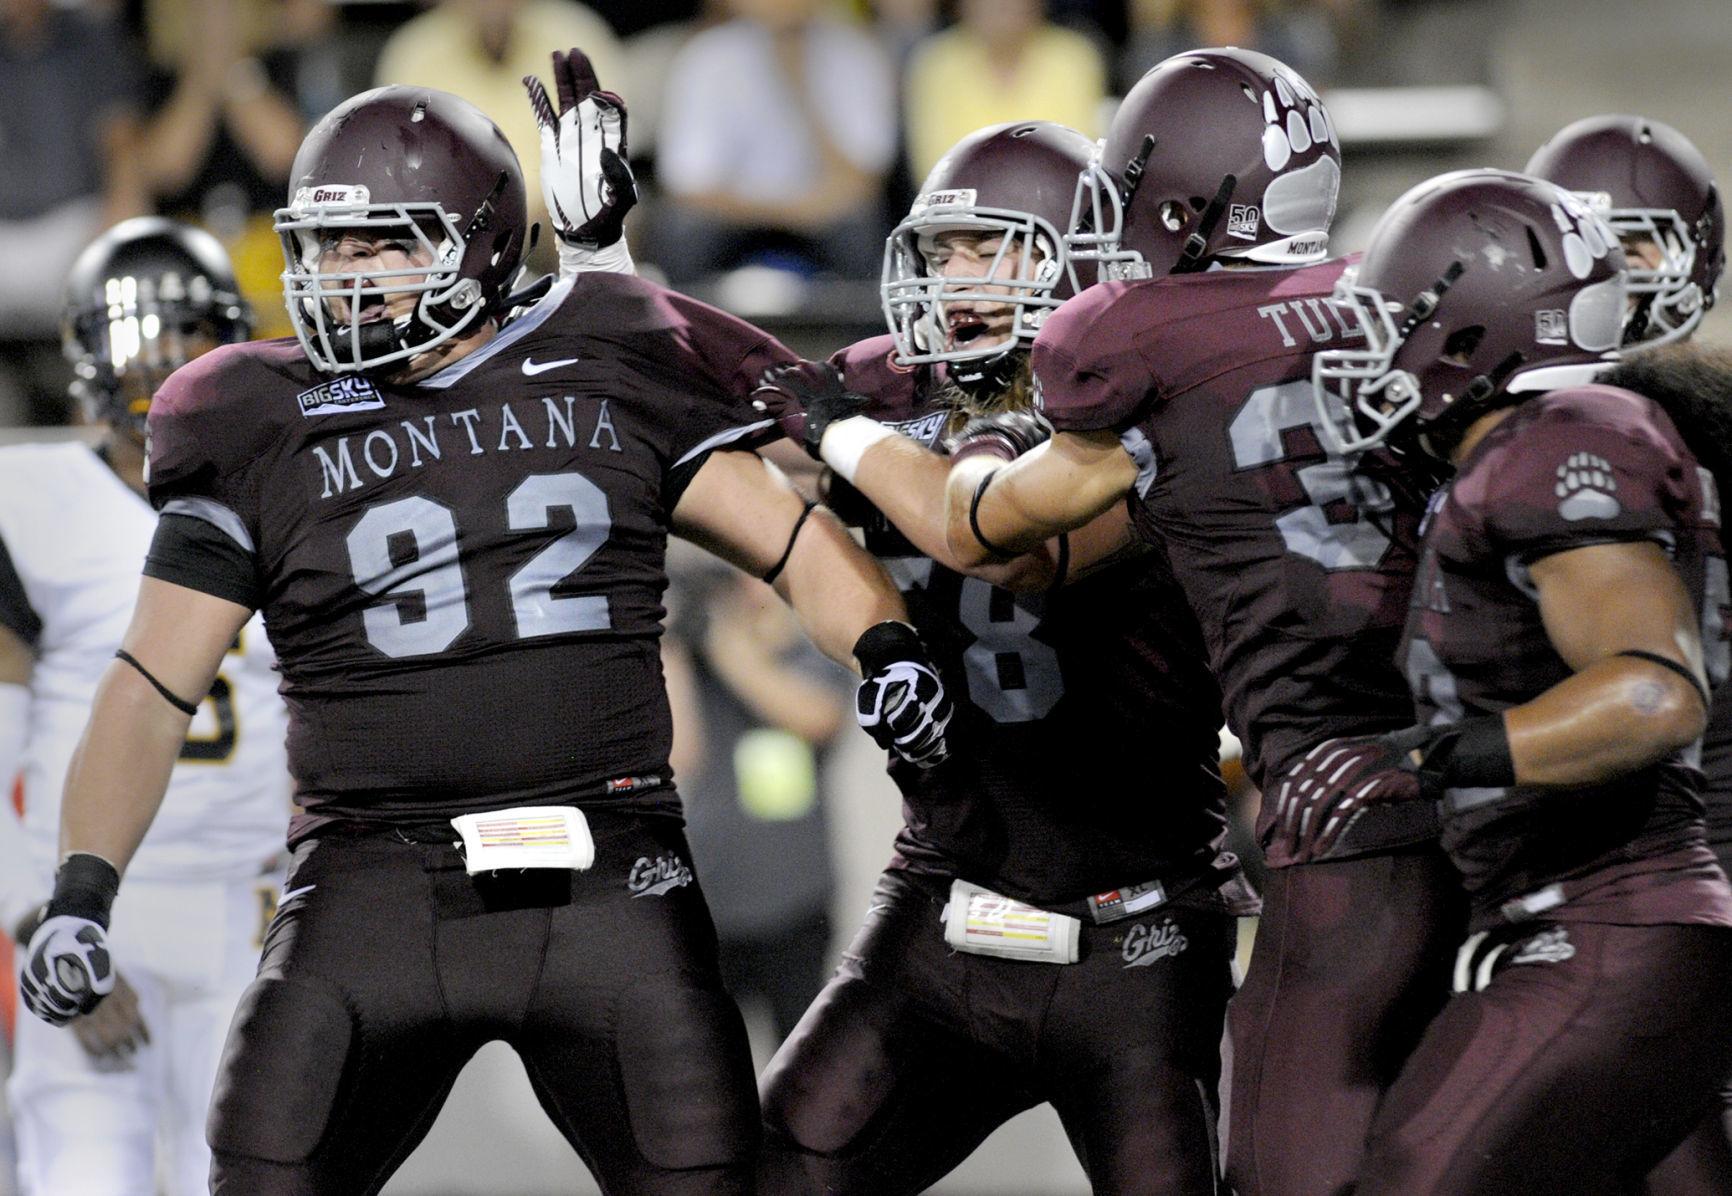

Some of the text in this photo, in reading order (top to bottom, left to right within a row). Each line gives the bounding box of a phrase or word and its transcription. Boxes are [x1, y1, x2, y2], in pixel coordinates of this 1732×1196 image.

[313, 188, 348, 203] GRIZ
[1230, 203, 1260, 223] 50
[312, 395, 622, 499] MONTANA
[345, 471, 613, 660] 92
[1121, 917, 1189, 969] Griz
